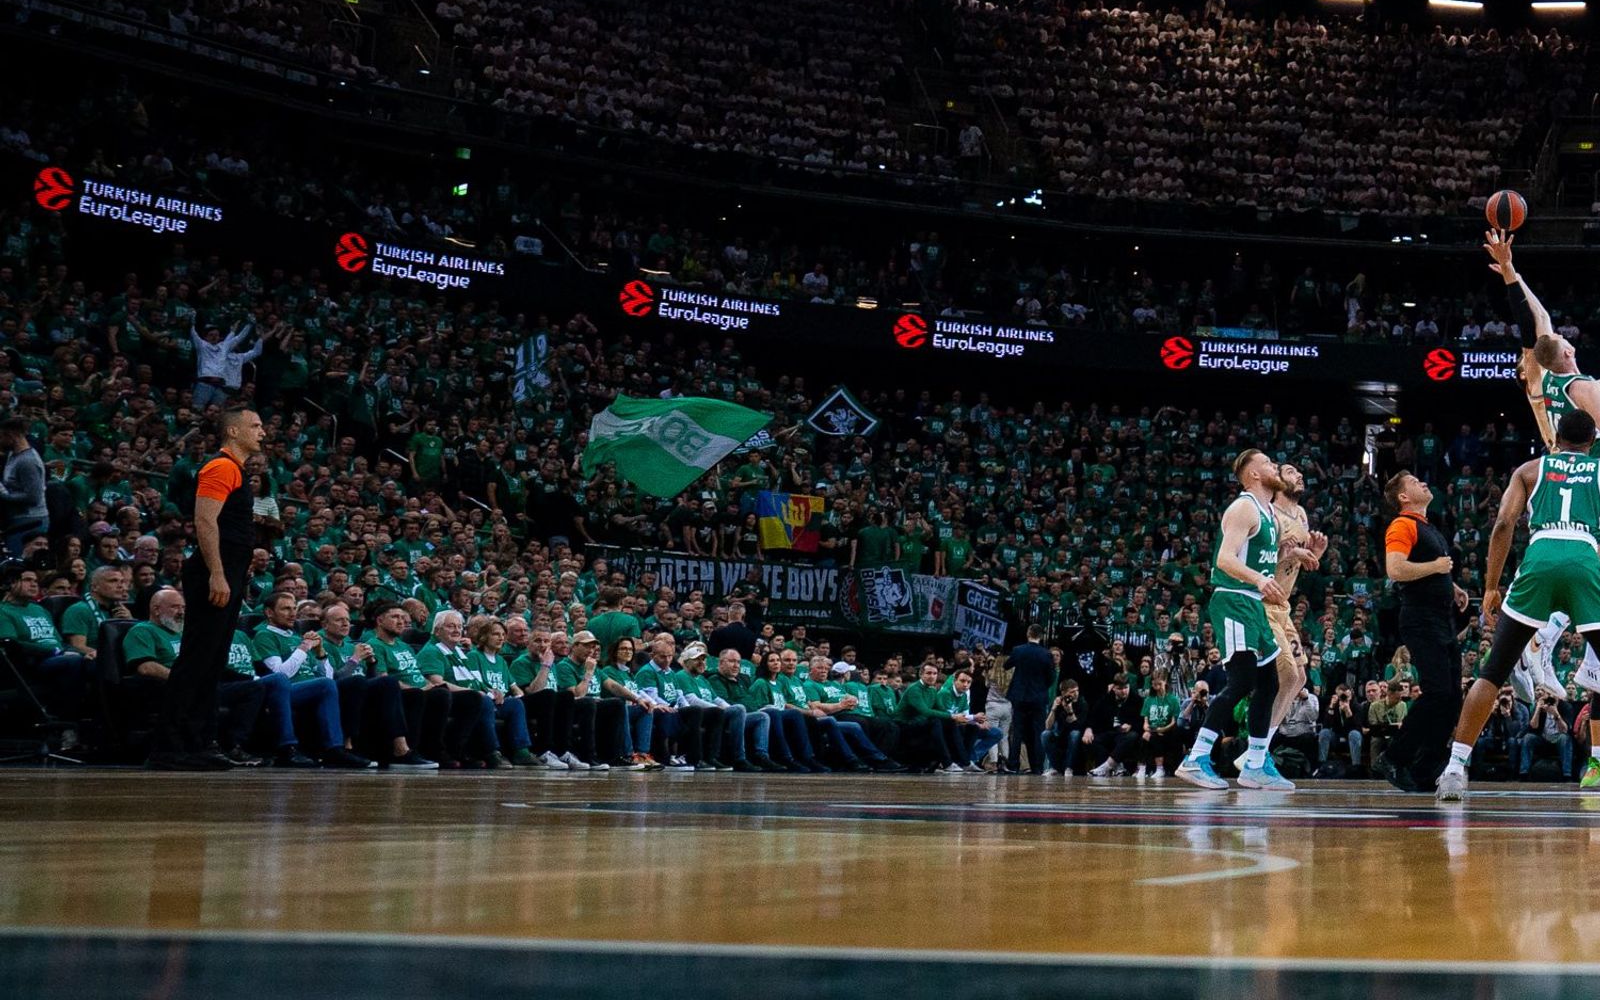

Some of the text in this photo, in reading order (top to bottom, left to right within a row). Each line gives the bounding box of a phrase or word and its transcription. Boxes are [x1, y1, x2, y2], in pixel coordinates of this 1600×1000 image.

[79, 195, 187, 233] EuroLeague
[82, 180, 223, 222] TURKISH AIRLINES
[372, 257, 470, 289] EuroLeague
[375, 243, 505, 275] TURKISH AIRLINES
[658, 302, 749, 330] EuroLeague
[661, 288, 780, 316] TURKISH AIRLINES
[932, 333, 1024, 357] EuroLeague
[935, 320, 1054, 342] TURKISH AIRLINES
[1200, 341, 1319, 357] TURKISH AIRLINES
[1462, 353, 1517, 363] TURKISH
[1199, 354, 1289, 374] EuroLeague
[1546, 458, 1596, 474] TAYLOR
[1559, 486, 1573, 522] 1
[787, 567, 839, 602] BOYS
[966, 588, 999, 614] GREE
